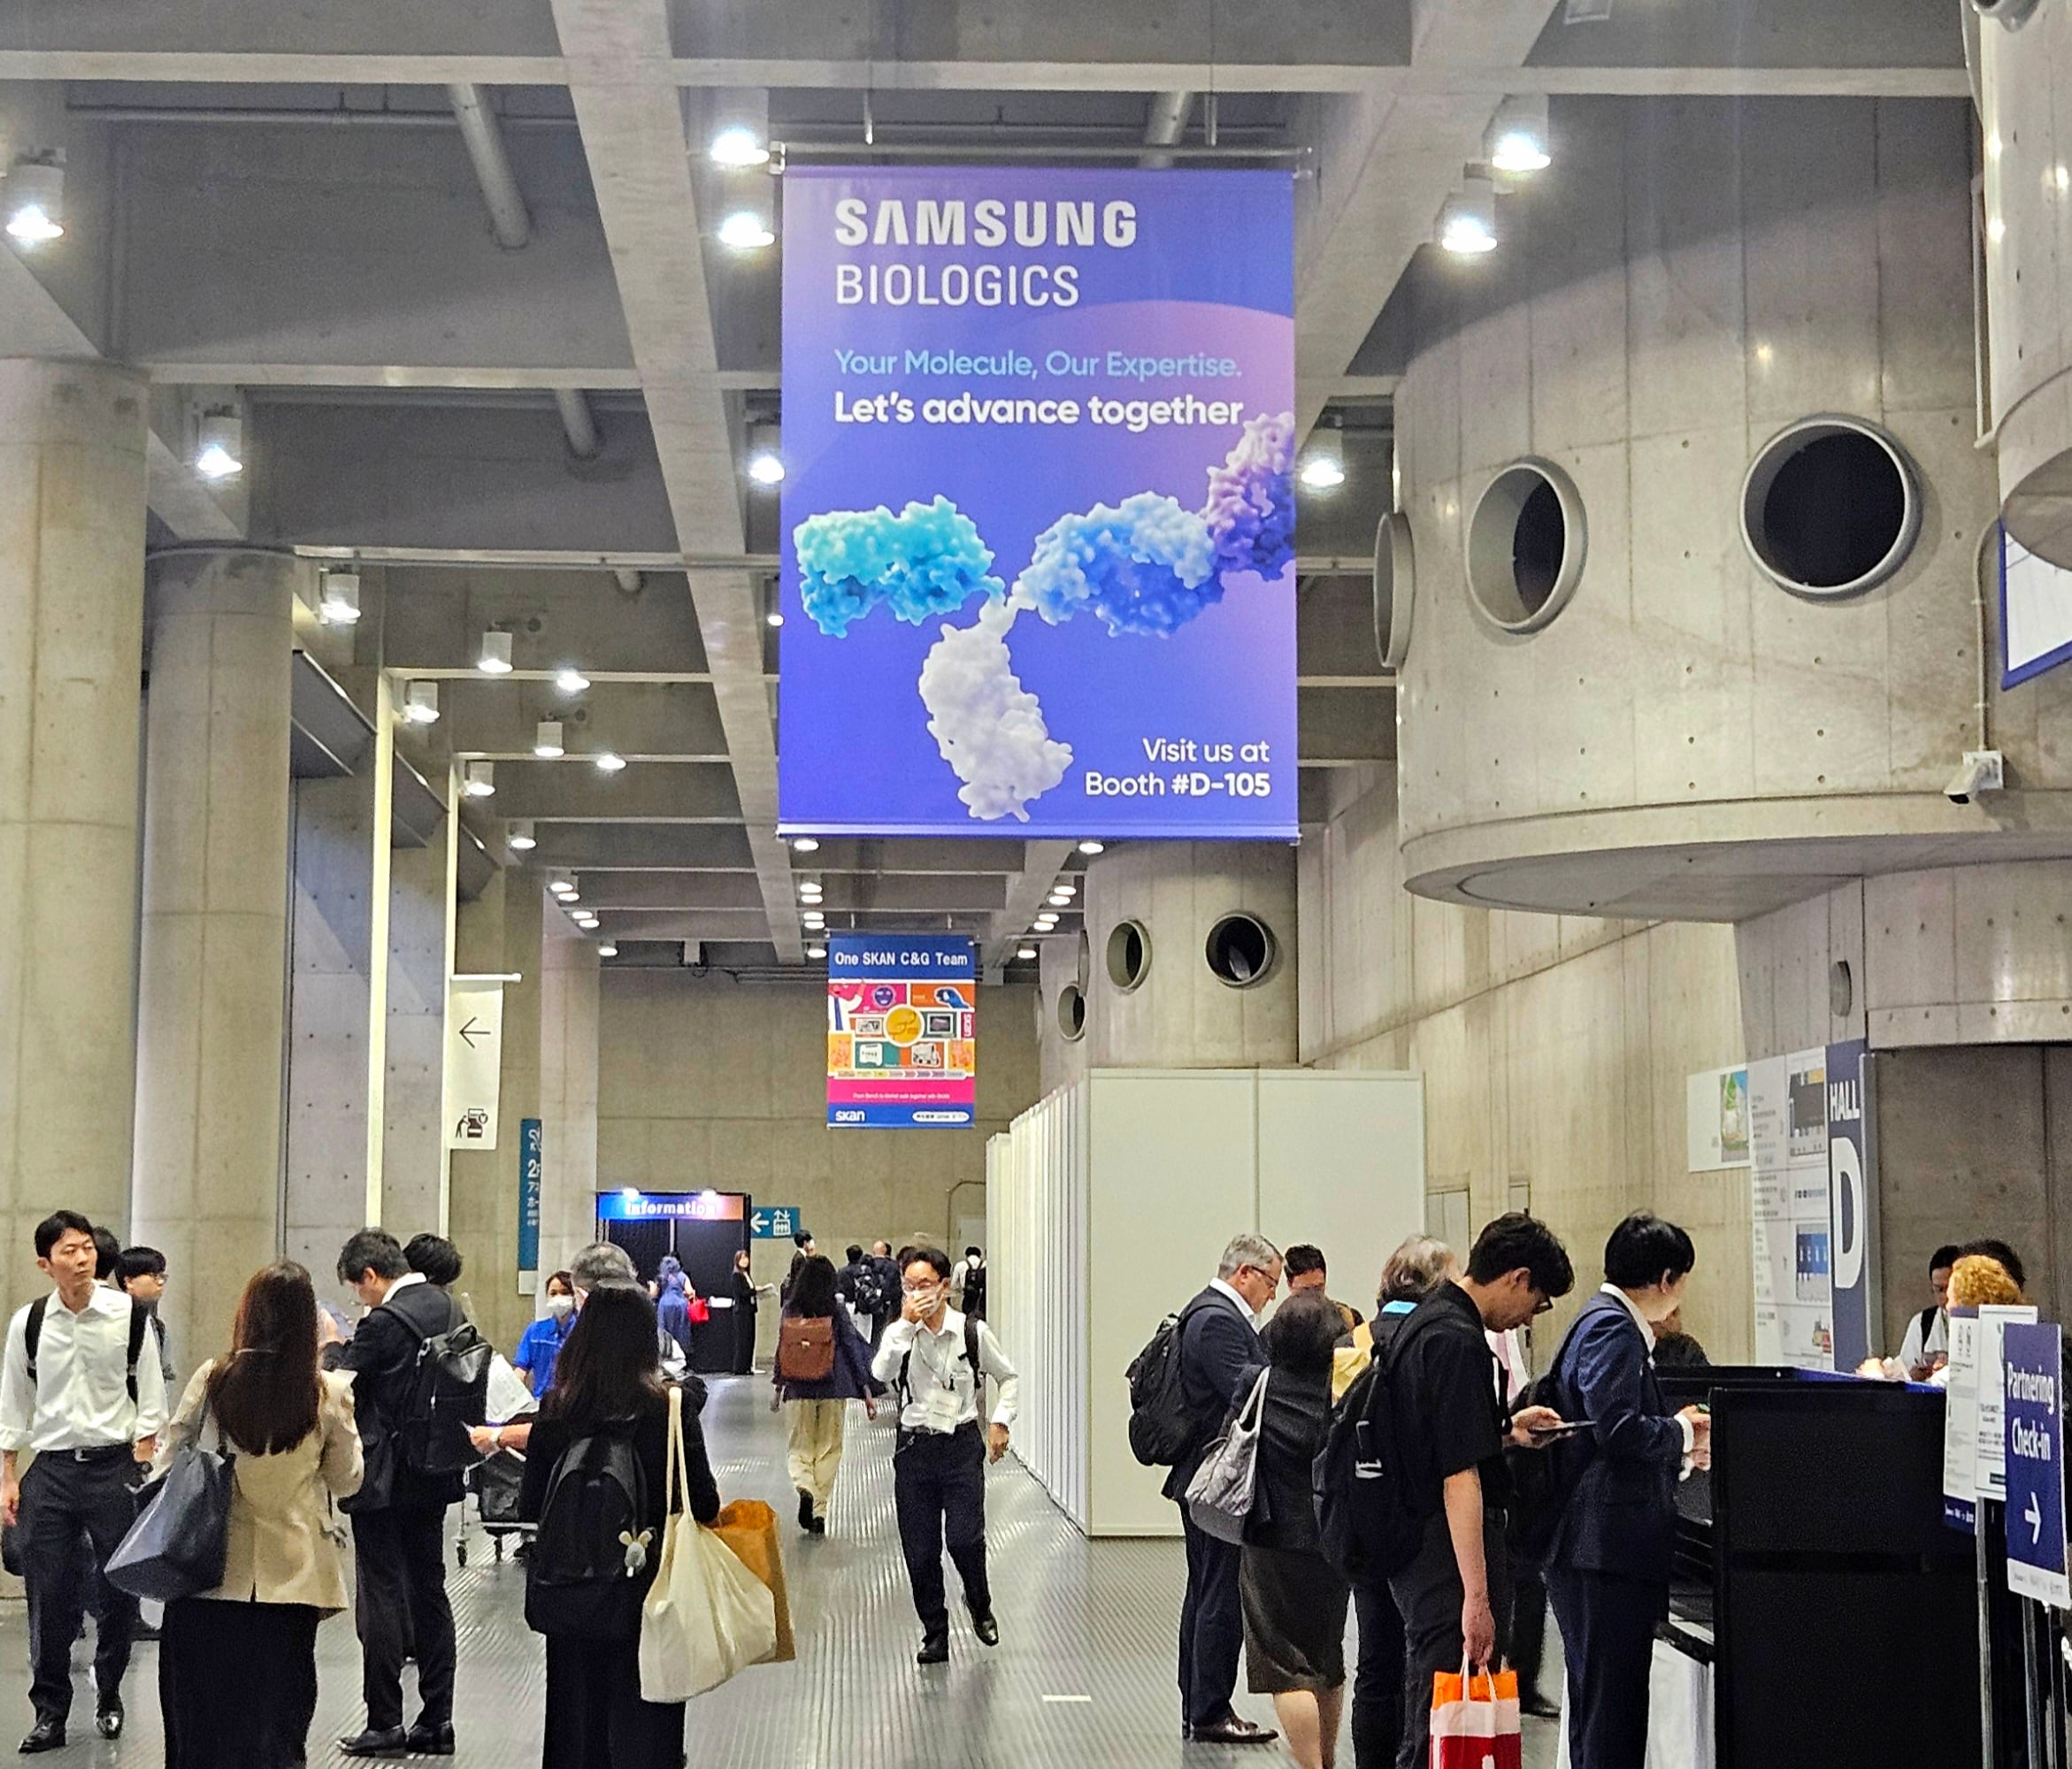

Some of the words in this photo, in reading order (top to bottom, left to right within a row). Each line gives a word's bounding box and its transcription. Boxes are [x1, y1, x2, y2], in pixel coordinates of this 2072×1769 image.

[835, 199, 1137, 248] SAMSUNG
[836, 264, 1079, 306] BIOLOGICS
[835, 349, 897, 376] Your
[904, 350, 1039, 380] Molecule,
[1046, 353, 1098, 377] Our
[1107, 353, 1242, 382] Expertise.
[834, 392, 914, 425] Let's
[923, 393, 1079, 425] advance
[1089, 394, 1243, 432] together
[1142, 738, 1197, 762] Visit
[1204, 743, 1233, 762] us
[1240, 740, 1270, 762] at
[1086, 771, 1165, 795] Booth
[1170, 772, 1270, 796] #D-105
[835, 952, 858, 965] One
[863, 952, 895, 965] SKAN
[901, 953, 930, 965] C&G
[935, 953, 968, 965] Team
[835, 1110, 865, 1122] skan
[1830, 1080, 1860, 1121] HALL
[626, 1201, 716, 1216] Information
[1831, 1137, 1863, 1289] D
[2007, 1361, 2054, 1414] Partnering
[2012, 1417, 2051, 1461] Check-in
